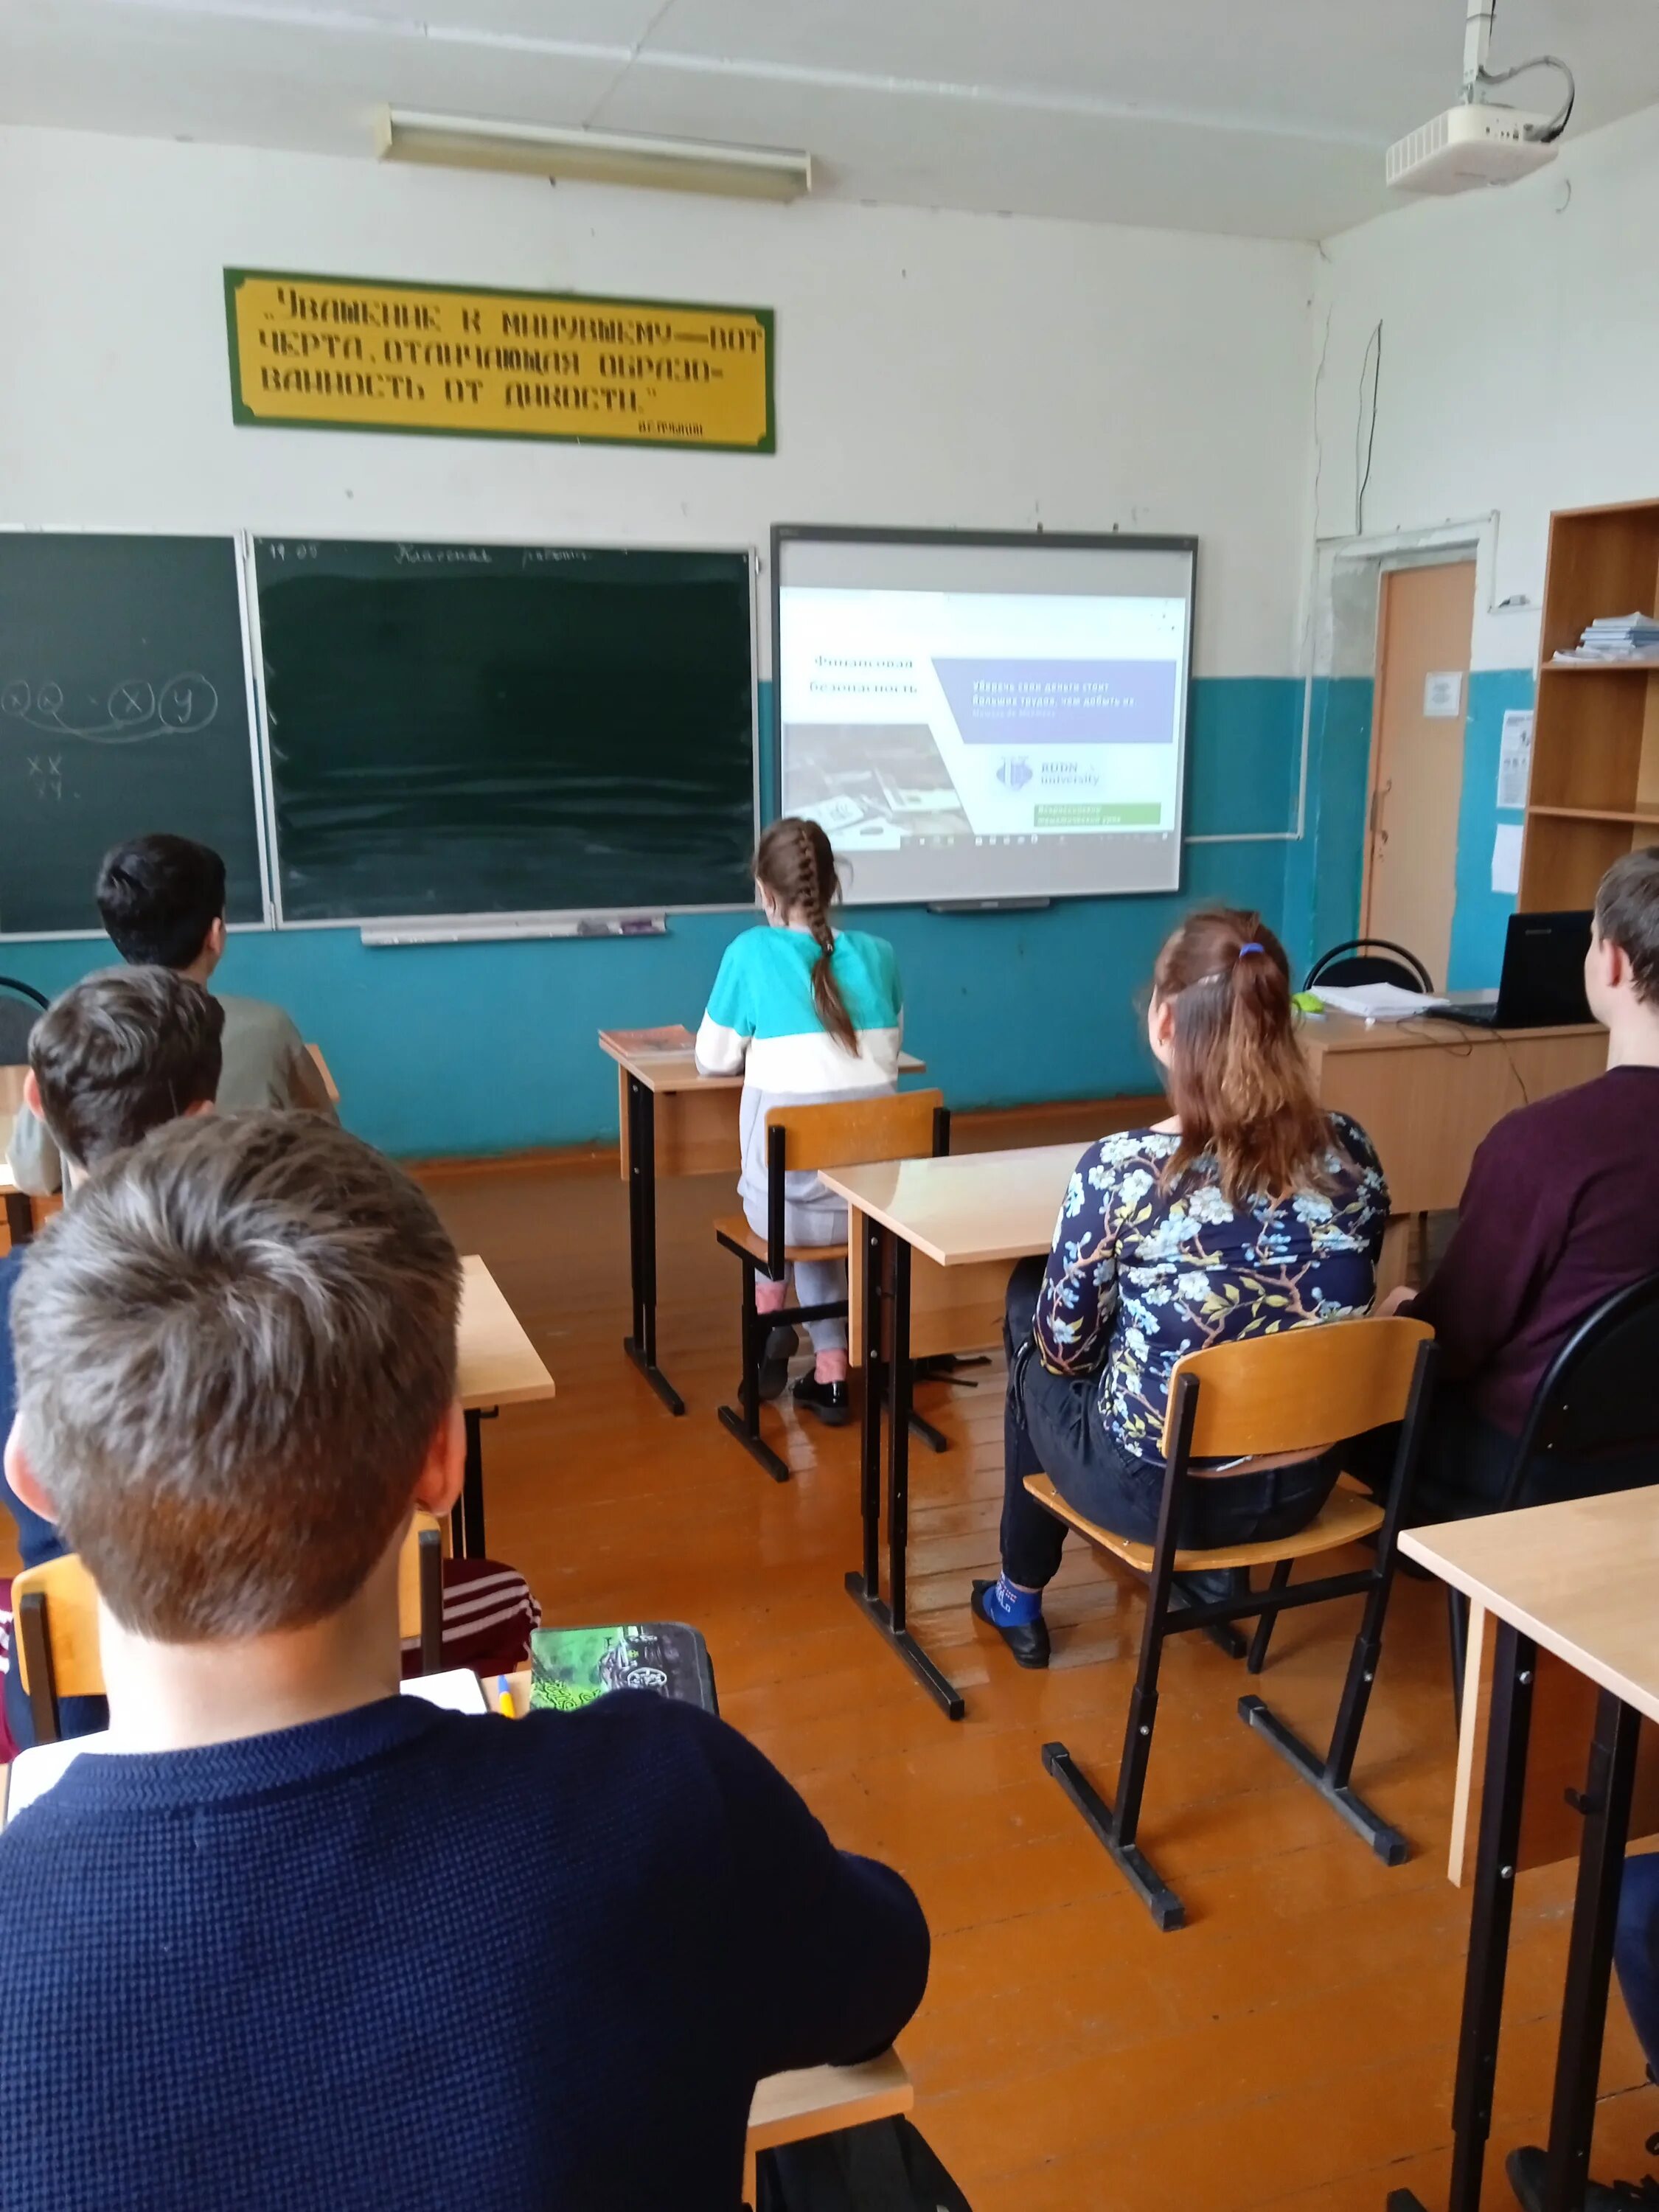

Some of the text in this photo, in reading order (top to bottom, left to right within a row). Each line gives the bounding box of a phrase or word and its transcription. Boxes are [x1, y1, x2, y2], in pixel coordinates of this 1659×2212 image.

[461, 305, 481, 335] К
[260, 365, 425, 402] ВАННОСТЬ
[444, 377, 484, 404] ОТ
[1041, 762, 1078, 774] RUDN
[1040, 774, 1100, 787] university
